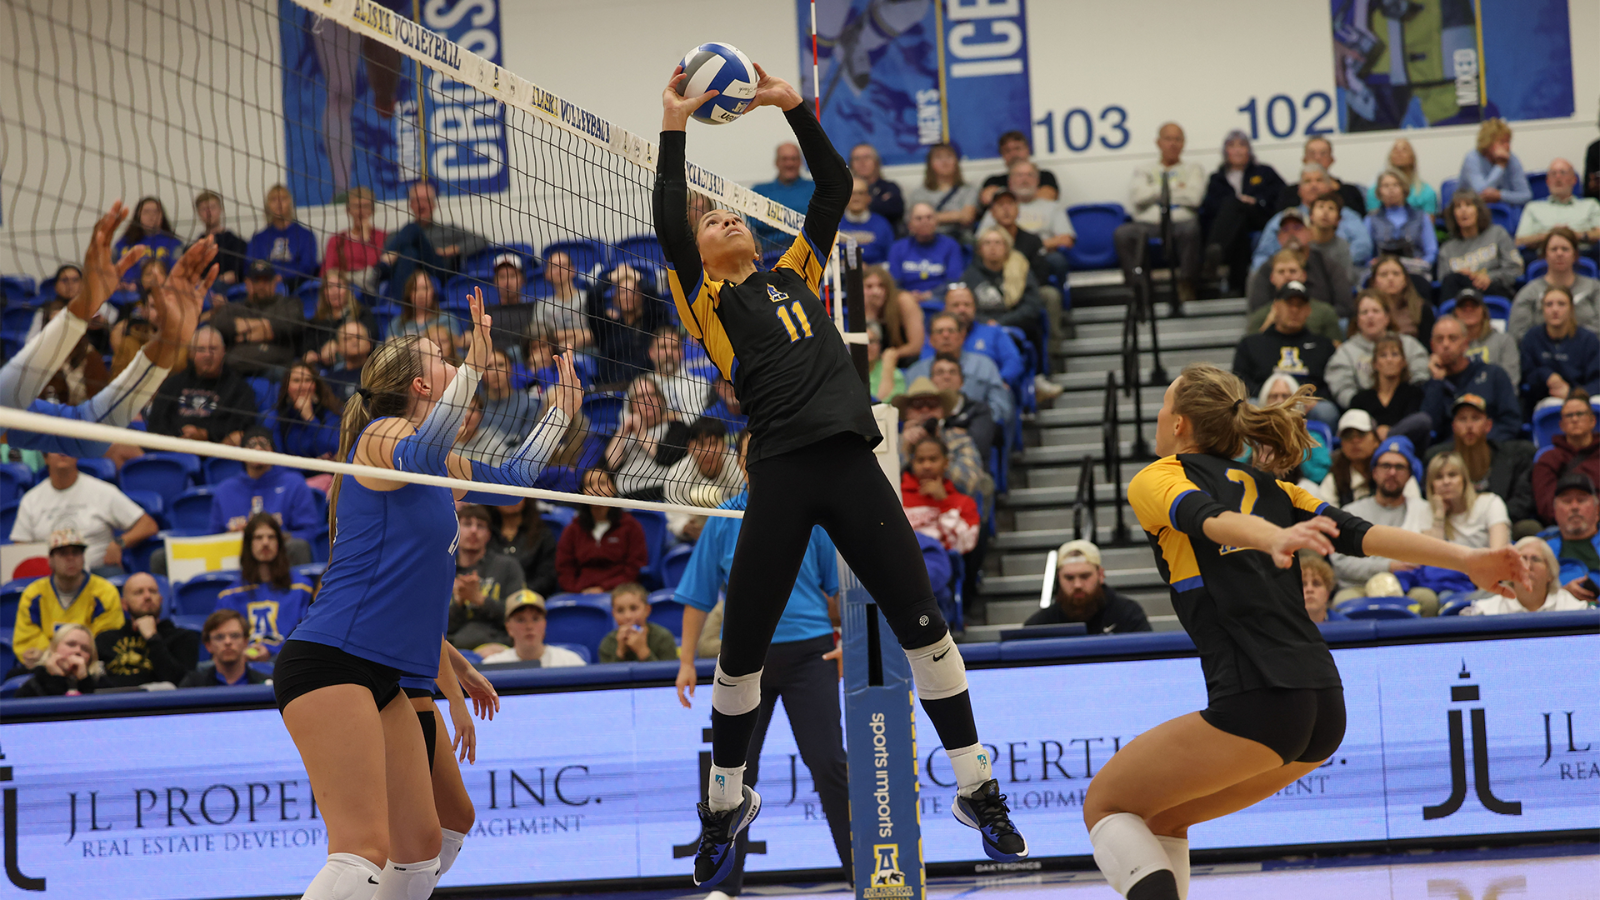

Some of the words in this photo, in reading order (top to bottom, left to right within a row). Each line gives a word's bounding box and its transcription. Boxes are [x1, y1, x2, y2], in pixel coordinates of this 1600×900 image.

[1033, 105, 1131, 153] 103
[1238, 91, 1335, 140] 102
[776, 299, 815, 343] 11
[869, 712, 889, 768] sports
[1539, 711, 1592, 768] JL
[65, 790, 112, 846] JL
[488, 764, 602, 809] INC.
[873, 770, 894, 838] imports
[82, 838, 133, 858] REAL
[142, 832, 216, 855] ESTATE
[224, 826, 329, 852] DEVELOP
[863, 886, 915, 899] ALASKA
